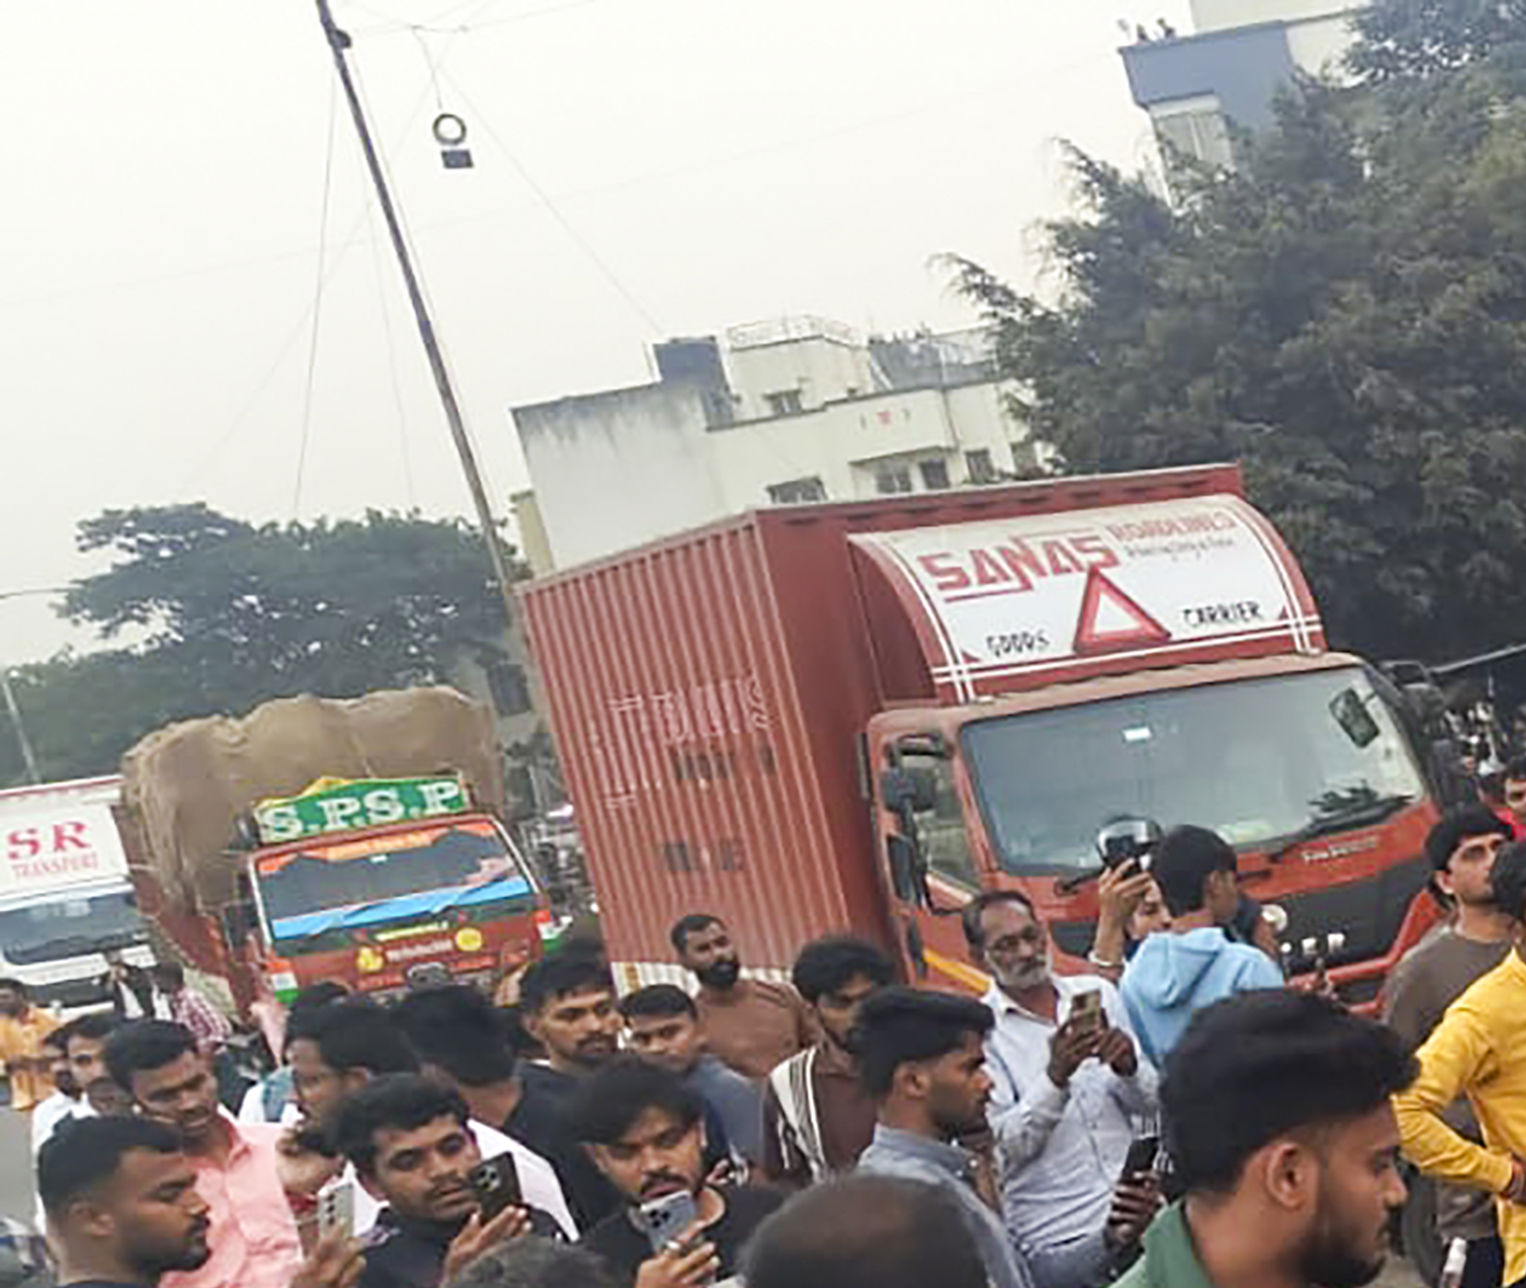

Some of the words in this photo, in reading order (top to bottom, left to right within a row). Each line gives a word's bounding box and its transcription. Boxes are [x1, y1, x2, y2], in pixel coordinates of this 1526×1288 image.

[917, 530, 1120, 602] SANAS
[986, 631, 1050, 657] GOODS
[1183, 601, 1263, 628] CARRIER
